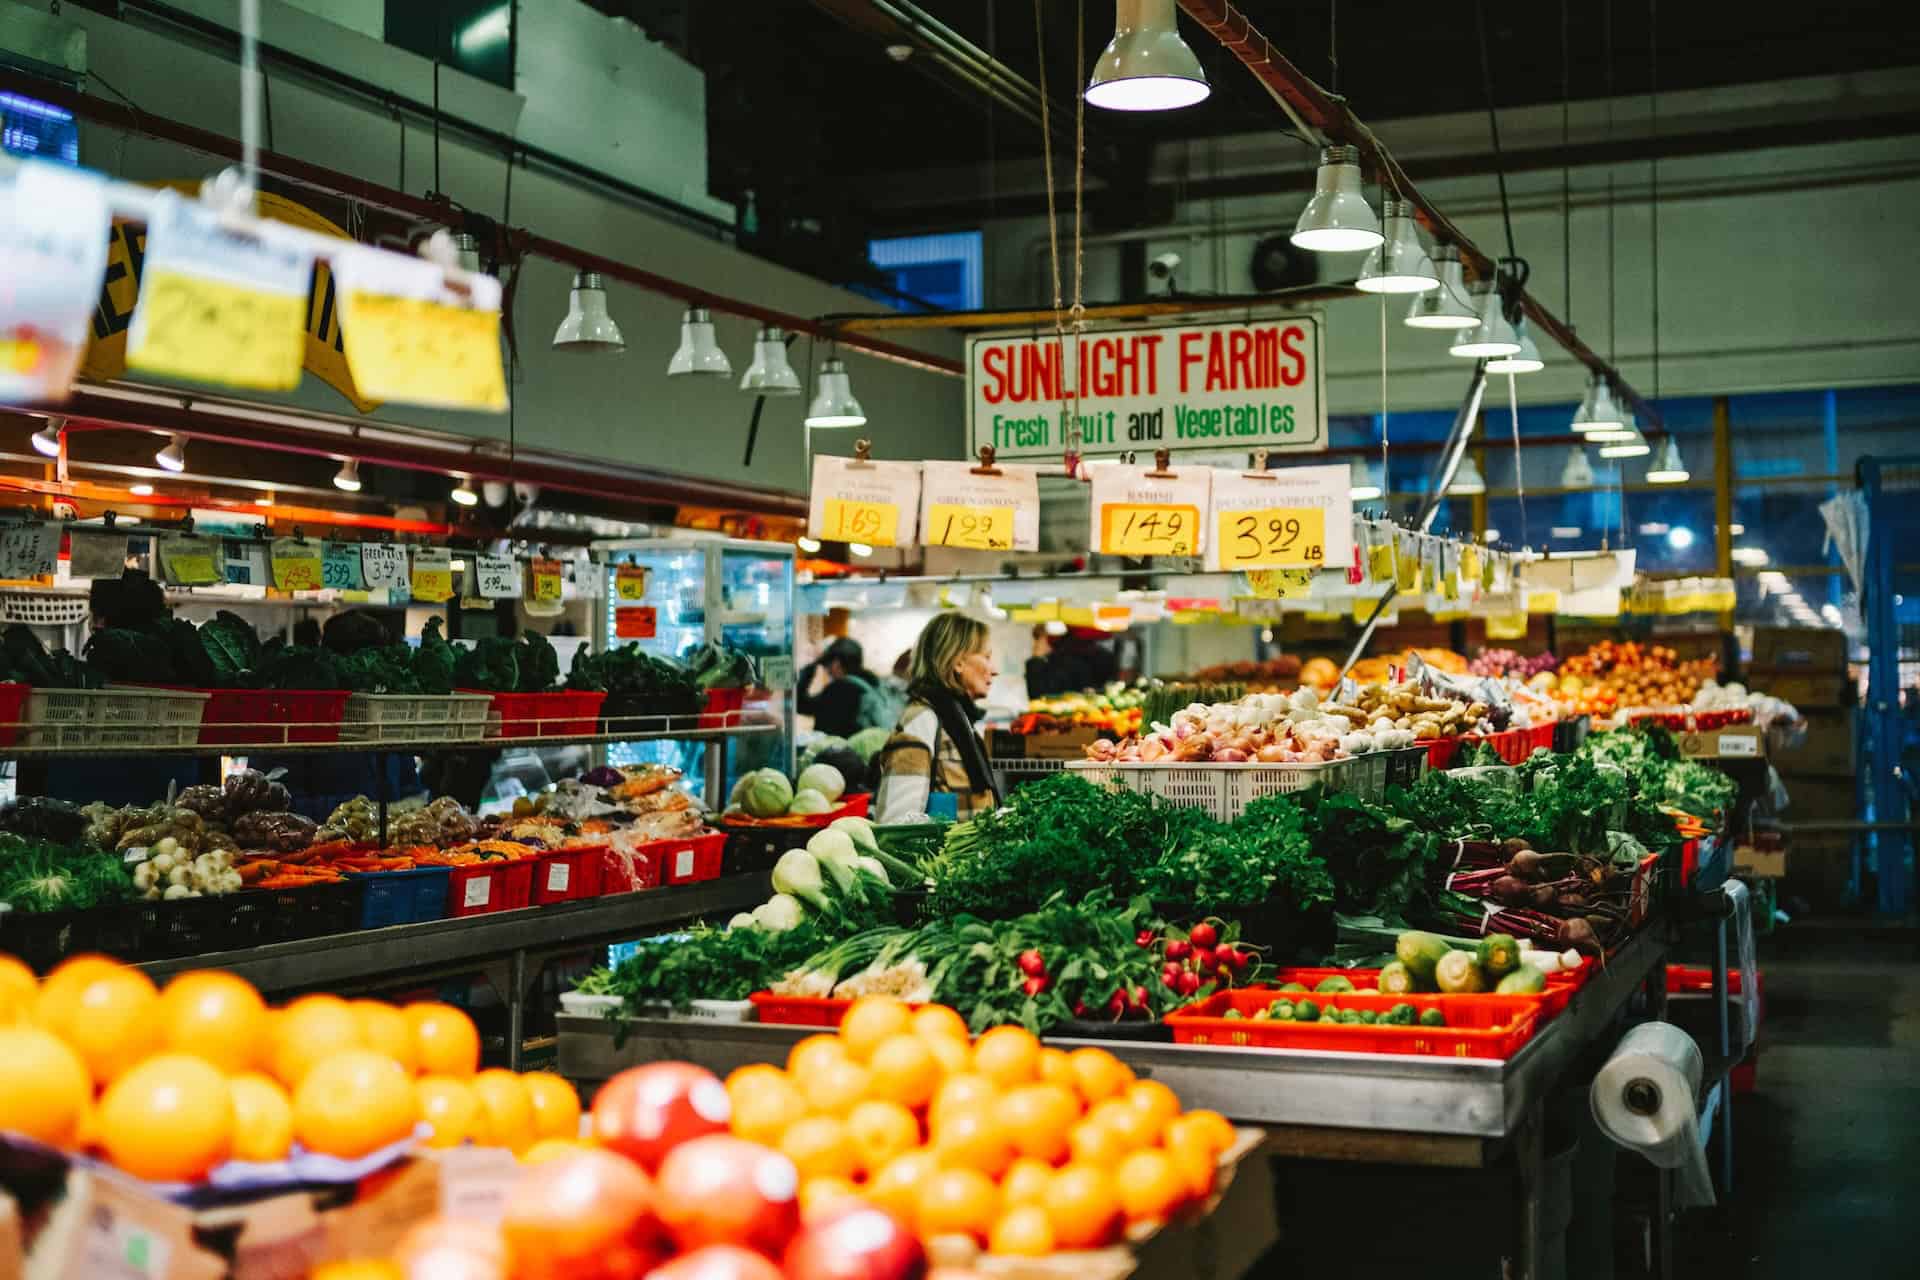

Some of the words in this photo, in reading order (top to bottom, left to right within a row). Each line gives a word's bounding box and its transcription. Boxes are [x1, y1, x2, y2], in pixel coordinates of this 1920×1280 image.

[982, 335, 1163, 404] SUNLIGHT
[1179, 326, 1306, 393] FARMS
[993, 414, 1049, 448] Fresh
[1128, 408, 1163, 441] and
[1175, 403, 1295, 439] Vegetables
[1303, 545, 1323, 560] LB
